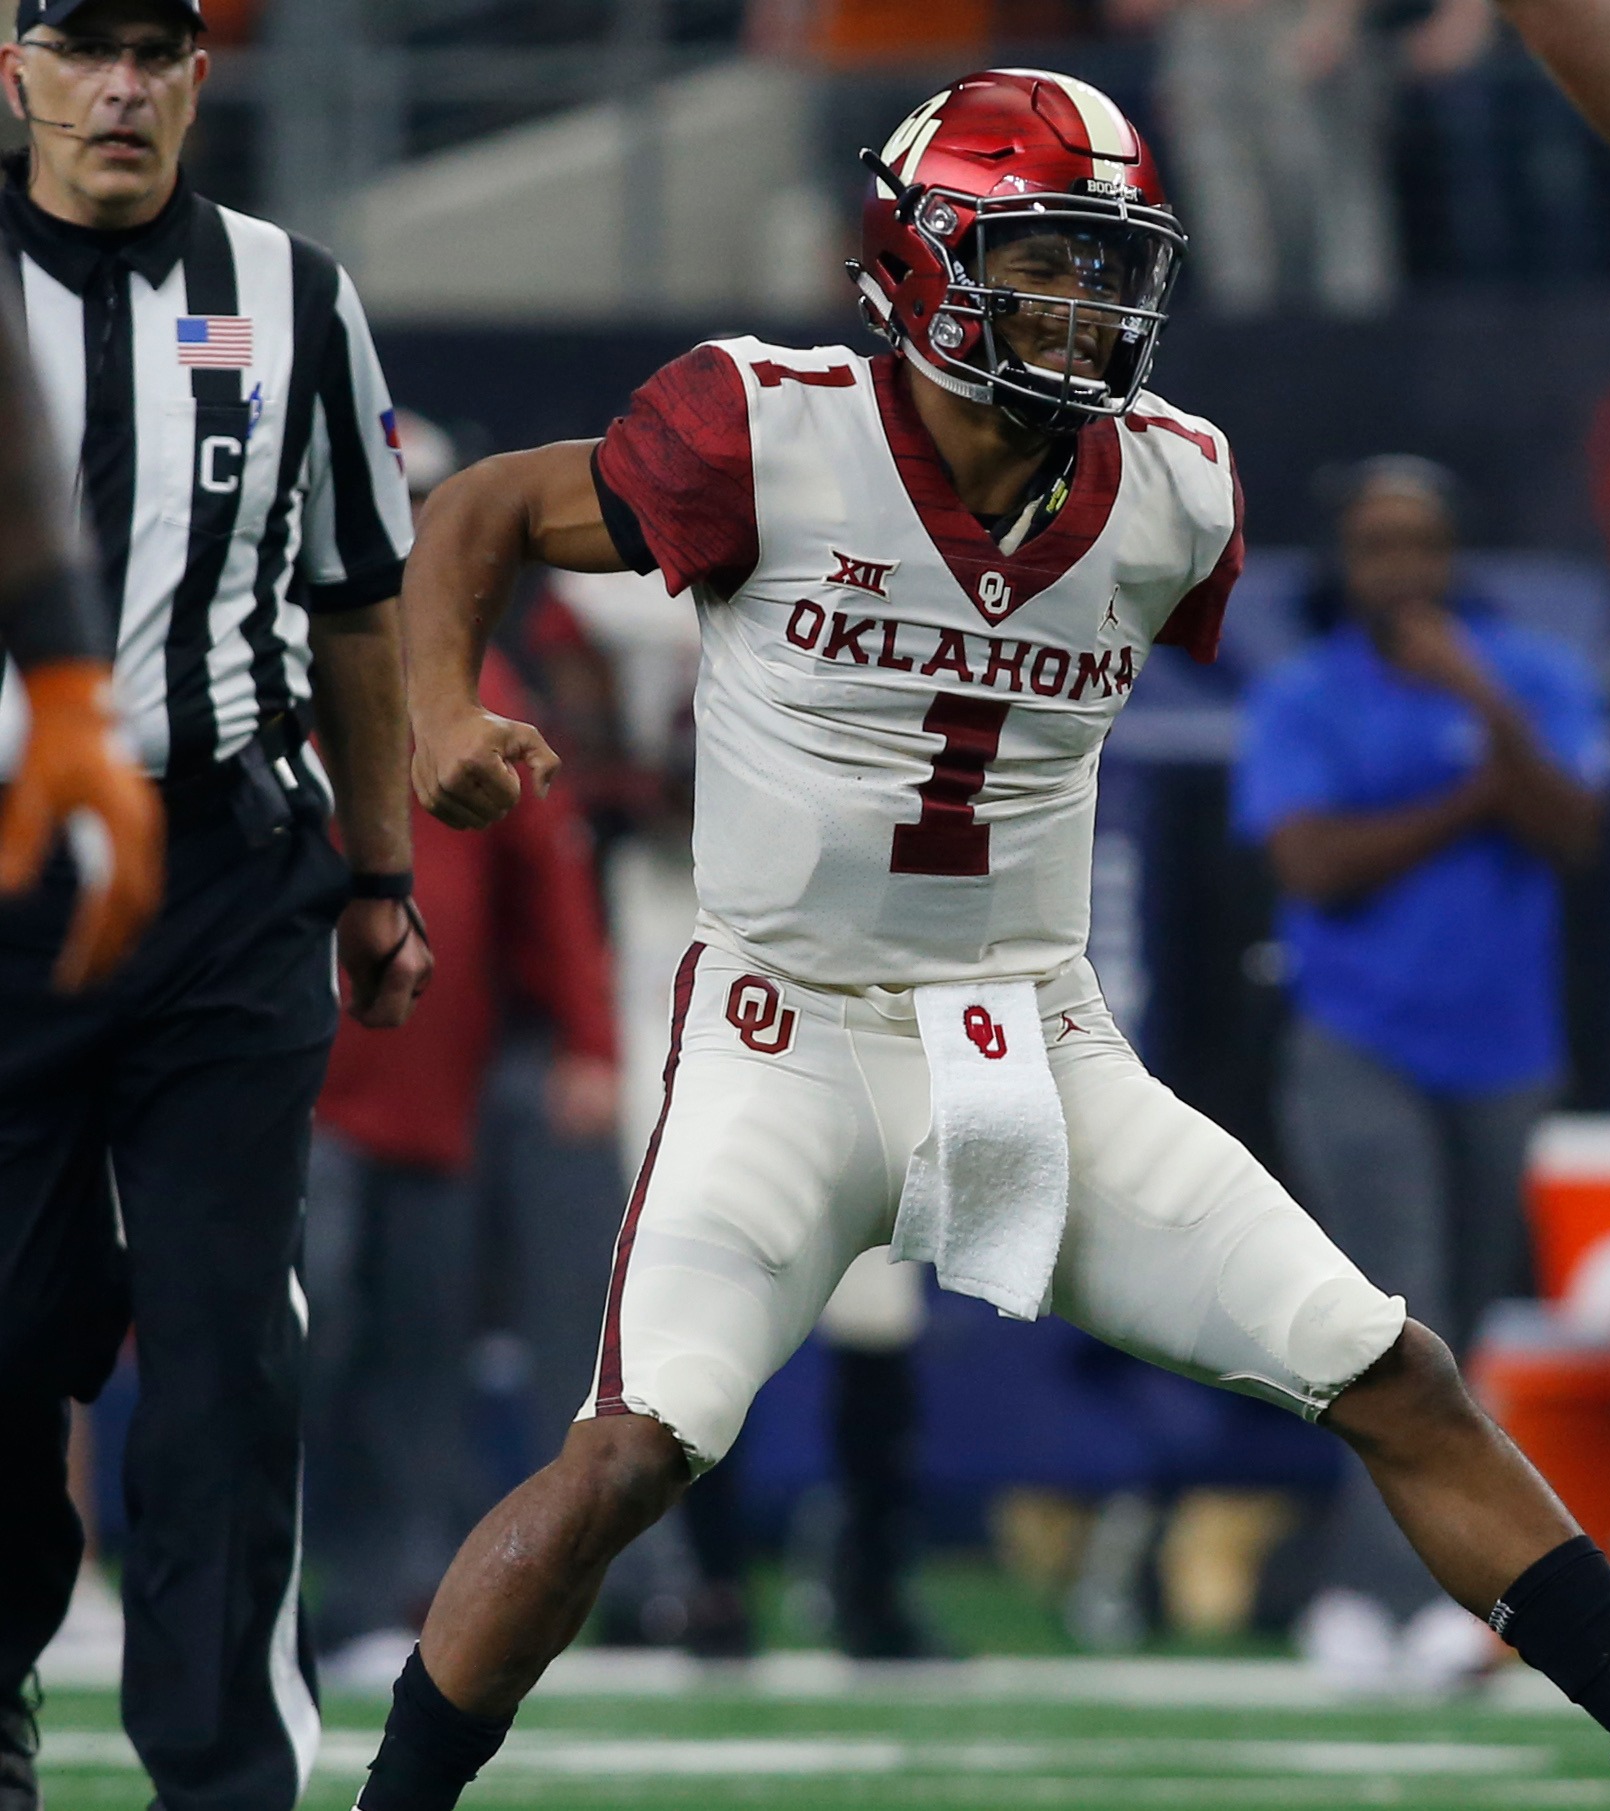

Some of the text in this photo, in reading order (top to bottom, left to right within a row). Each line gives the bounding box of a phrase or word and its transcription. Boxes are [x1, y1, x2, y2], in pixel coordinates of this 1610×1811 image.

[749, 359, 857, 388] 1
[200, 435, 242, 493] C
[826, 549, 894, 597] XII
[978, 571, 1011, 614] OU
[786, 599, 1133, 700] OKLAHOMA
[889, 690, 1011, 877] 1
[725, 974, 796, 1055] OU
[962, 1005, 1008, 1060] OU
